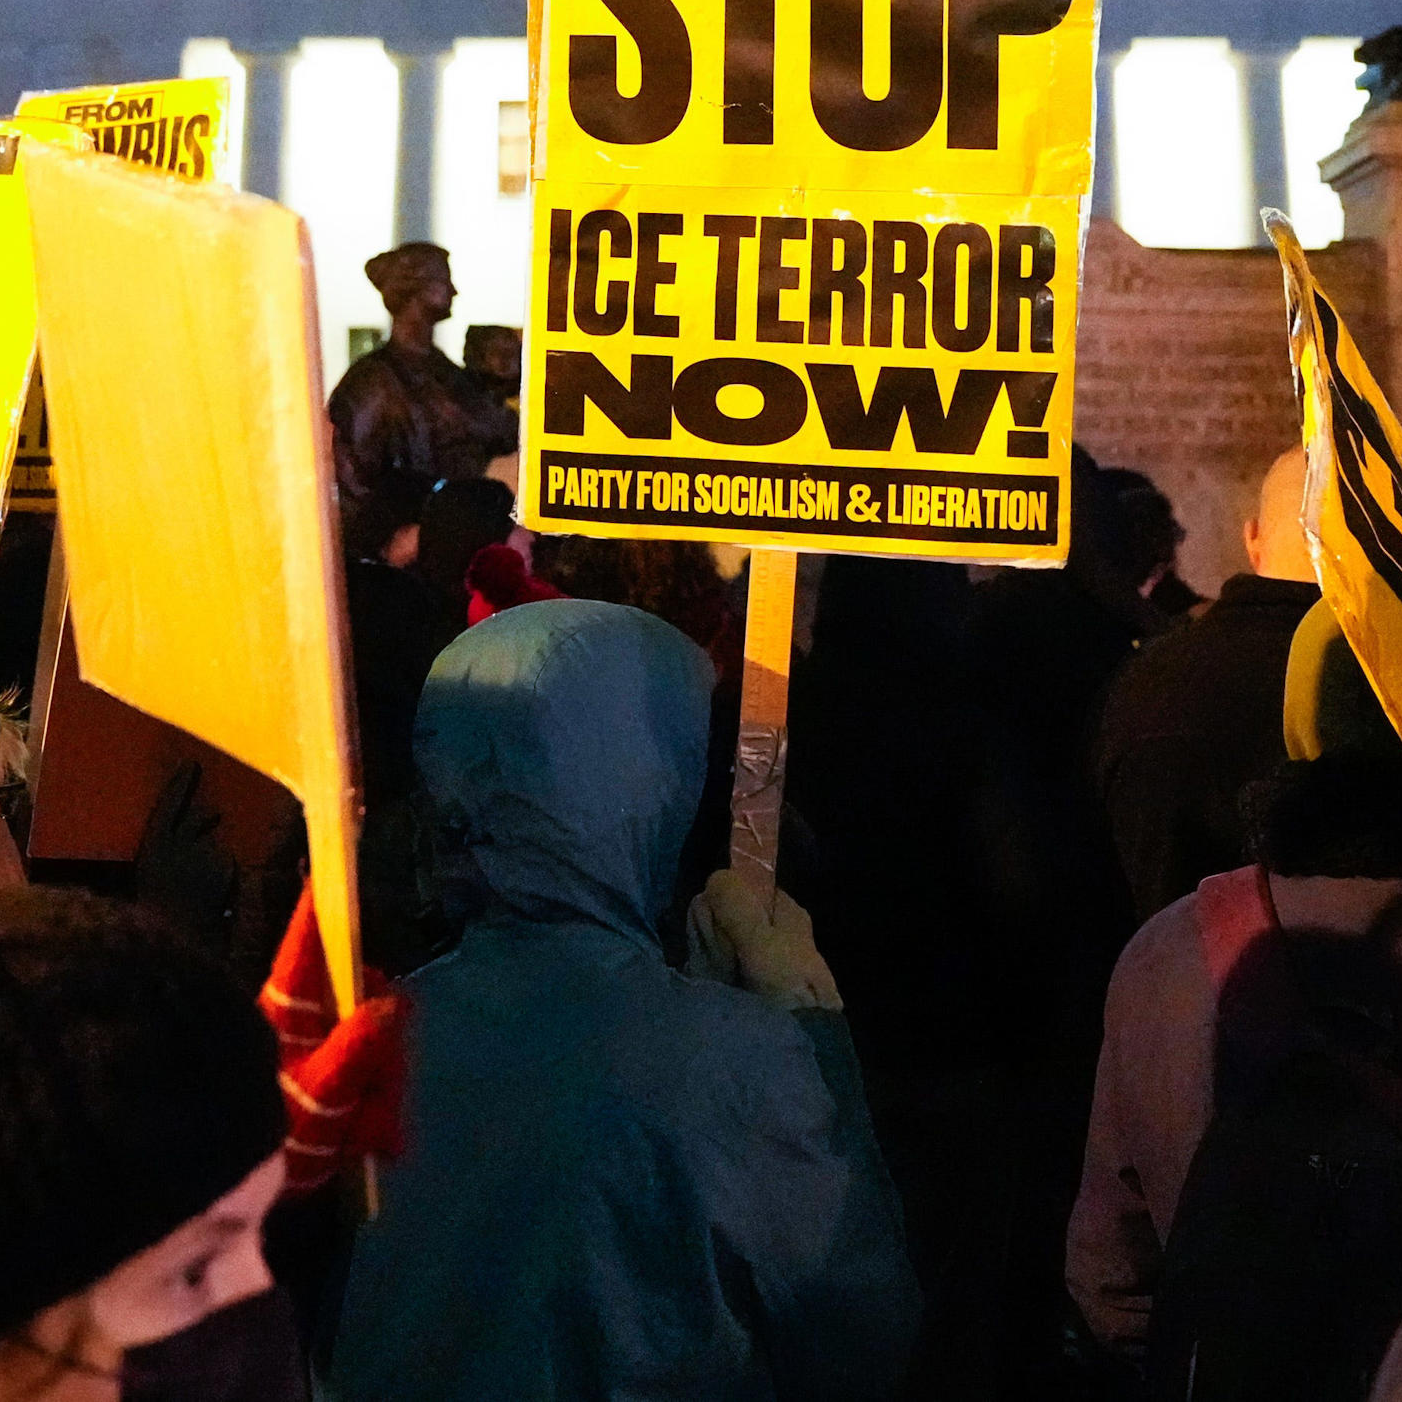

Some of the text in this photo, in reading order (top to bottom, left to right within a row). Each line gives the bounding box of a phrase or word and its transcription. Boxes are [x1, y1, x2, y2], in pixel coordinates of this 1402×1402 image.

[65, 98, 154, 124] FROM
[547, 208, 1056, 354] ICE TERROR
[544, 350, 1058, 460] NOW!
[548, 465, 1048, 532] PARTY FOR SOCIALISM & LIBERATION
